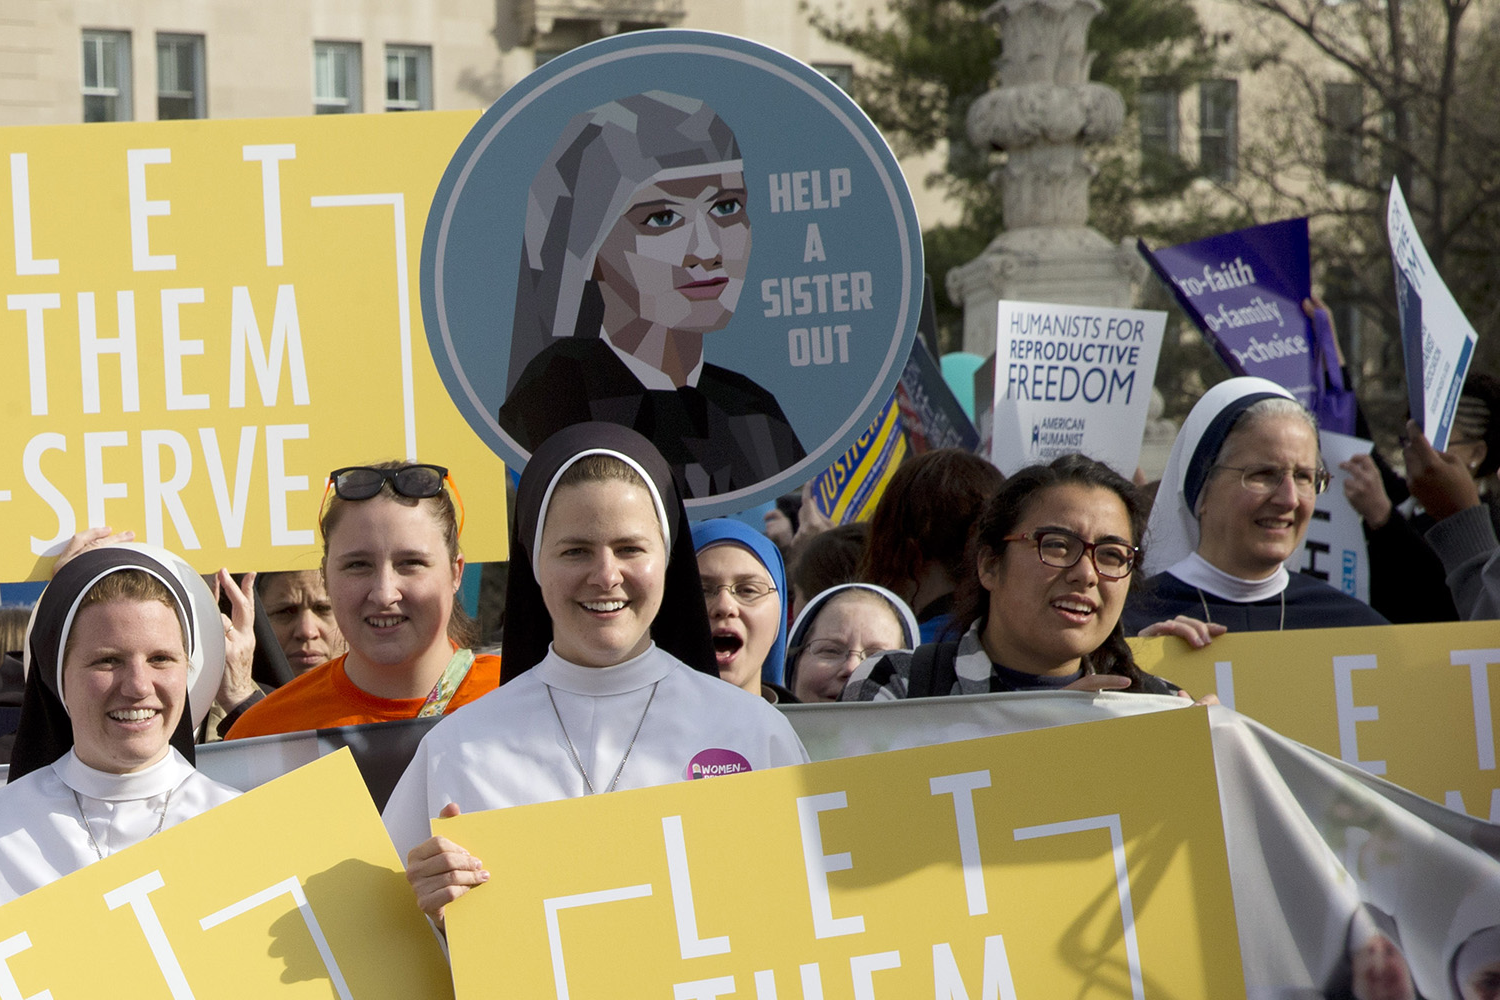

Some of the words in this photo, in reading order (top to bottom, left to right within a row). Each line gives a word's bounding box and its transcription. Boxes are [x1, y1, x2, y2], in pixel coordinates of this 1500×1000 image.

[10, 144, 296, 275] LET
[769, 168, 852, 213] HELP
[803, 223, 826, 263] A
[761, 271, 873, 318] SISTER
[1172, 257, 1256, 297] ro-faith
[1010, 312, 1102, 339] HUMANISTS
[1106, 318, 1145, 342] FOR
[1204, 296, 1284, 332] o-family
[7, 284, 310, 415] THEM
[788, 325, 852, 367] OUT
[1009, 339, 1140, 365] REPRODUCTIVE
[1007, 364, 1136, 405] FREEDOM
[1039, 432, 1084, 447] HUMANIST
[1041, 417, 1085, 431] AMERICAN
[23, 424, 314, 557] SERVE
[701, 763, 741, 774] WOMEN
[661, 769, 991, 960] LET
